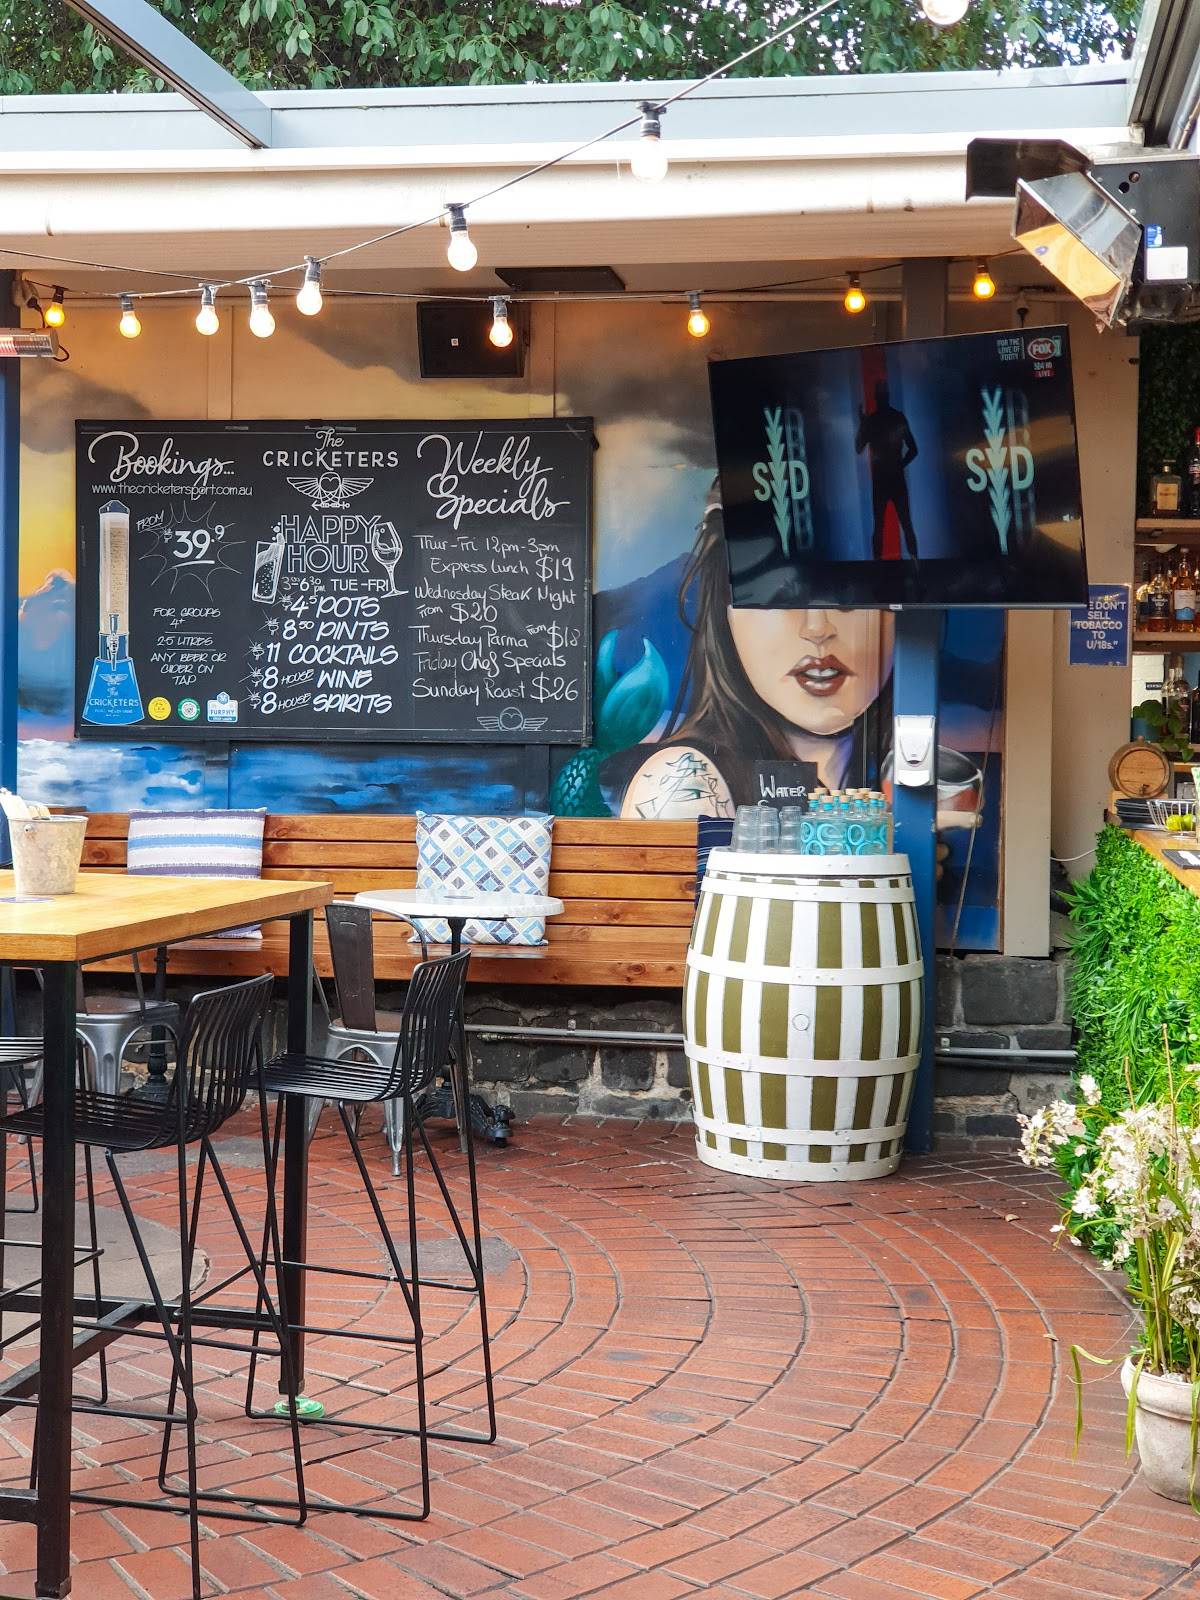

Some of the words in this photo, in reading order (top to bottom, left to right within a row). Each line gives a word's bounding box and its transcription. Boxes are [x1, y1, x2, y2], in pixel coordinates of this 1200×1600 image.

[998, 346, 1012, 354] LOVE
[1033, 342, 1052, 355] FOX
[315, 428, 345, 450] The
[262, 451, 399, 471] CRICKETERS
[416, 431, 554, 498] Weekly
[91, 482, 253, 499] www.thecricketersport.com.au
[426, 473, 571, 530] Specials
[136, 509, 165, 531] FROM
[280, 514, 382, 544] HAPPY
[287, 544, 370, 573] HOUR
[430, 557, 487, 578] Express
[535, 554, 574, 581] $19
[414, 577, 487, 608] Wednesday
[538, 585, 577, 610] Night
[152, 607, 176, 617] FOR
[180, 607, 221, 618] GROUPS
[316, 595, 380, 618] POTS
[416, 604, 443, 618] From
[450, 602, 498, 624] $20
[1087, 611, 1111, 620] SELL
[1095, 601, 1127, 611] DON'T
[316, 621, 390, 641] PINTS
[1074, 620, 1123, 630] TOBACCO
[1092, 630, 1106, 640] TO
[177, 636, 214, 647] LITRES
[408, 625, 482, 655] Thursday
[480, 625, 529, 648] Parma
[546, 620, 581, 651] $18
[150, 652, 176, 663] ANY
[180, 653, 208, 663] BEER
[211, 652, 227, 662] OR
[288, 643, 399, 665] COCKTAILS
[412, 651, 457, 678] Friday
[461, 650, 500, 678] Chef
[503, 651, 566, 674] Specials
[160, 663, 194, 674] CIDER
[197, 664, 215, 674] ON
[281, 668, 315, 688] HOUSE
[316, 669, 374, 689] WINE
[172, 674, 197, 686] TAP
[412, 678, 479, 705] Sunday
[484, 677, 526, 698] Roast
[530, 671, 579, 703] $26
[89, 698, 140, 708] CRICKETERS
[277, 692, 313, 711] HOUSE
[313, 693, 393, 714] SPIRITS
